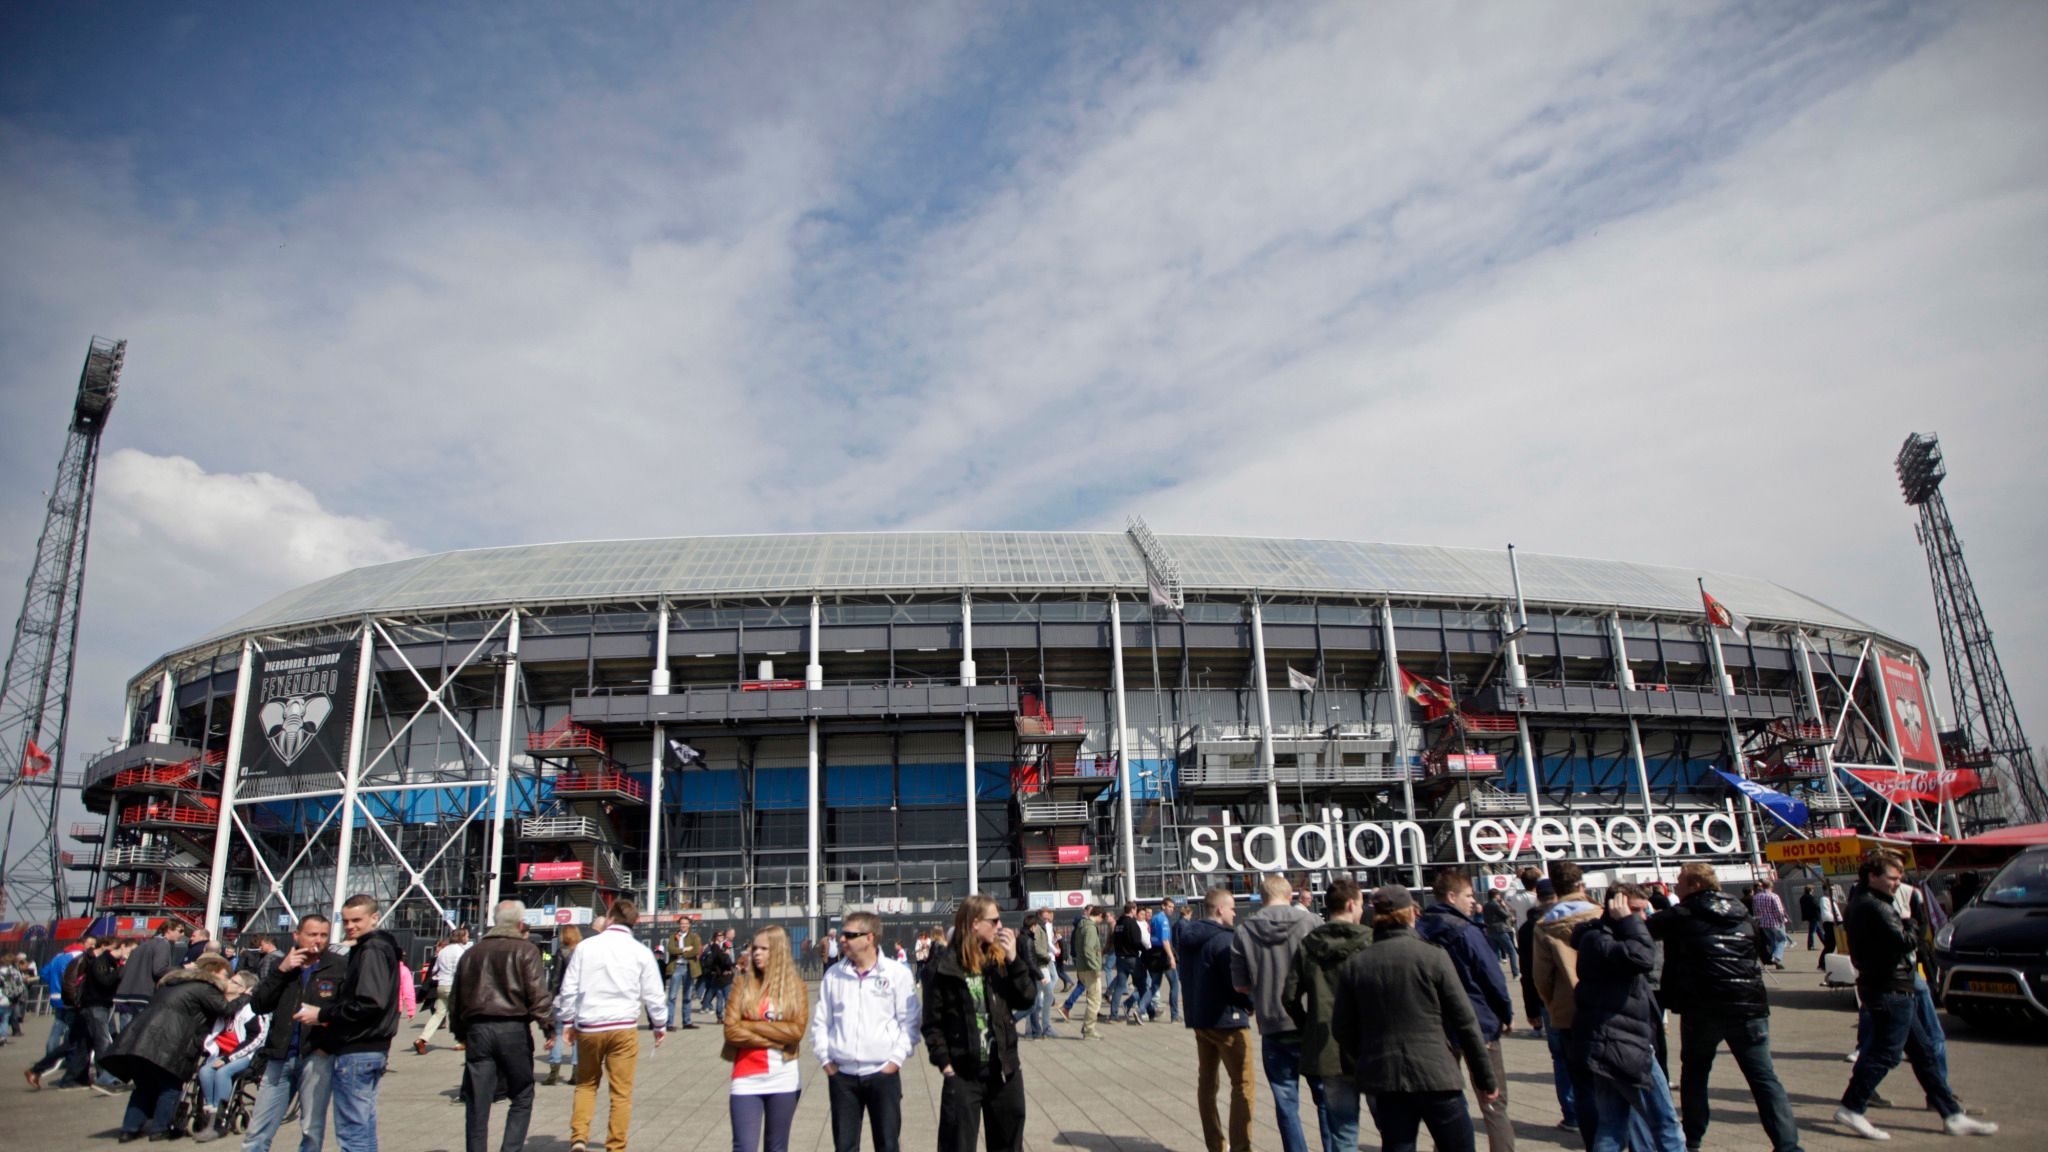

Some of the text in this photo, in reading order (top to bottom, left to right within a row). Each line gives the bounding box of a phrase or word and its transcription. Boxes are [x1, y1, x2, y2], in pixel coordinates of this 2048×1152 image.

[260, 669, 339, 703] FEYENOORD
[1190, 797, 1742, 873] stadion feyenoord
[1782, 841, 1841, 857] HOT DOGS
